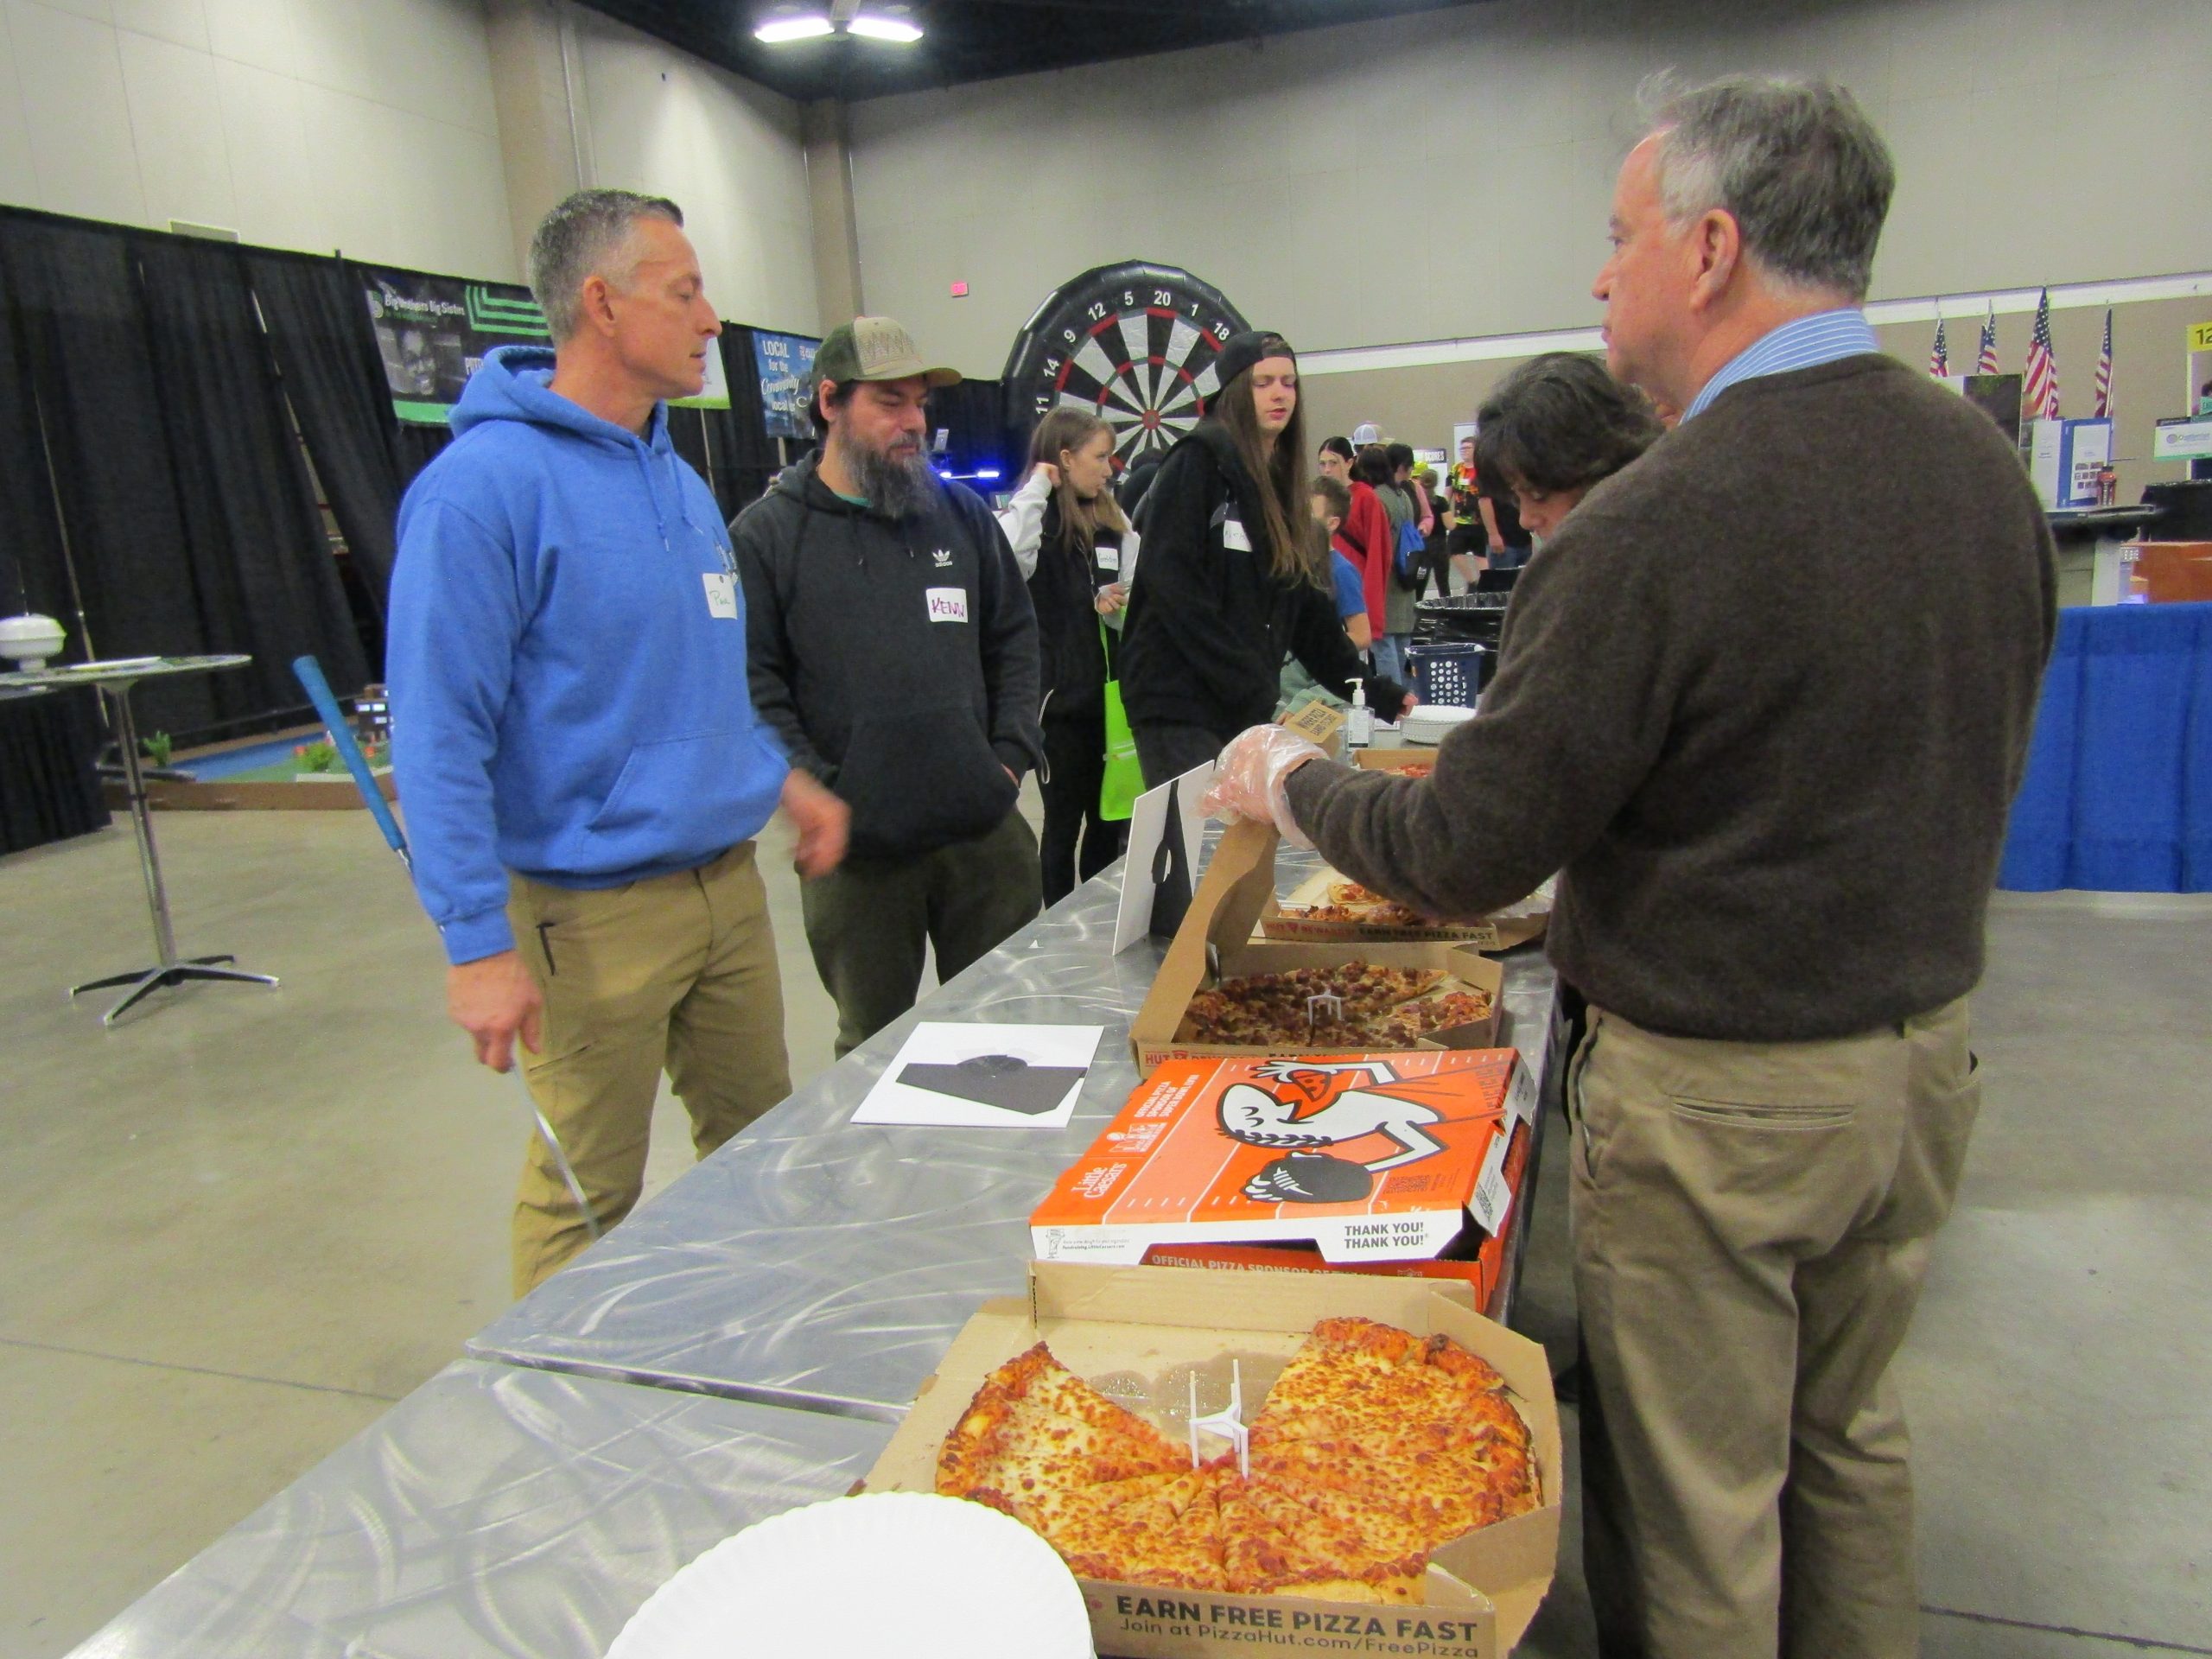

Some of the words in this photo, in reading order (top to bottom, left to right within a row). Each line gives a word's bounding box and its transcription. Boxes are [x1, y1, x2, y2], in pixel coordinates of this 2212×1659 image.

[1124, 291, 1135, 306] 5
[1153, 290, 1172, 307] 20
[1088, 302, 1107, 321] 12
[1191, 303, 1199, 317] 1
[1064, 329, 1077, 344] 9
[1213, 322, 1230, 341] 18
[763, 340, 790, 359] LOCAL
[1043, 358, 1060, 378] 14
[1071, 1166, 1109, 1192] Little
[1084, 1162, 1128, 1198] Caesars
[1344, 1224, 1389, 1236] THANK
[1392, 1222, 1424, 1233] YOU!
[1344, 1236, 1389, 1249] THANK
[1152, 1255, 1205, 1269] OFFICIAL
[1210, 1260, 1245, 1272] PIZZA
[1116, 1595, 1201, 1622] EARN
[1211, 1605, 1283, 1629] FREE
[1293, 1610, 1386, 1637] PIZZA
[1396, 1618, 1478, 1642] FAST
[1121, 1618, 1162, 1635] Join
[1170, 1623, 1193, 1637] at
[1199, 1624, 1478, 1658] PizzaHut.com/FreePizza
